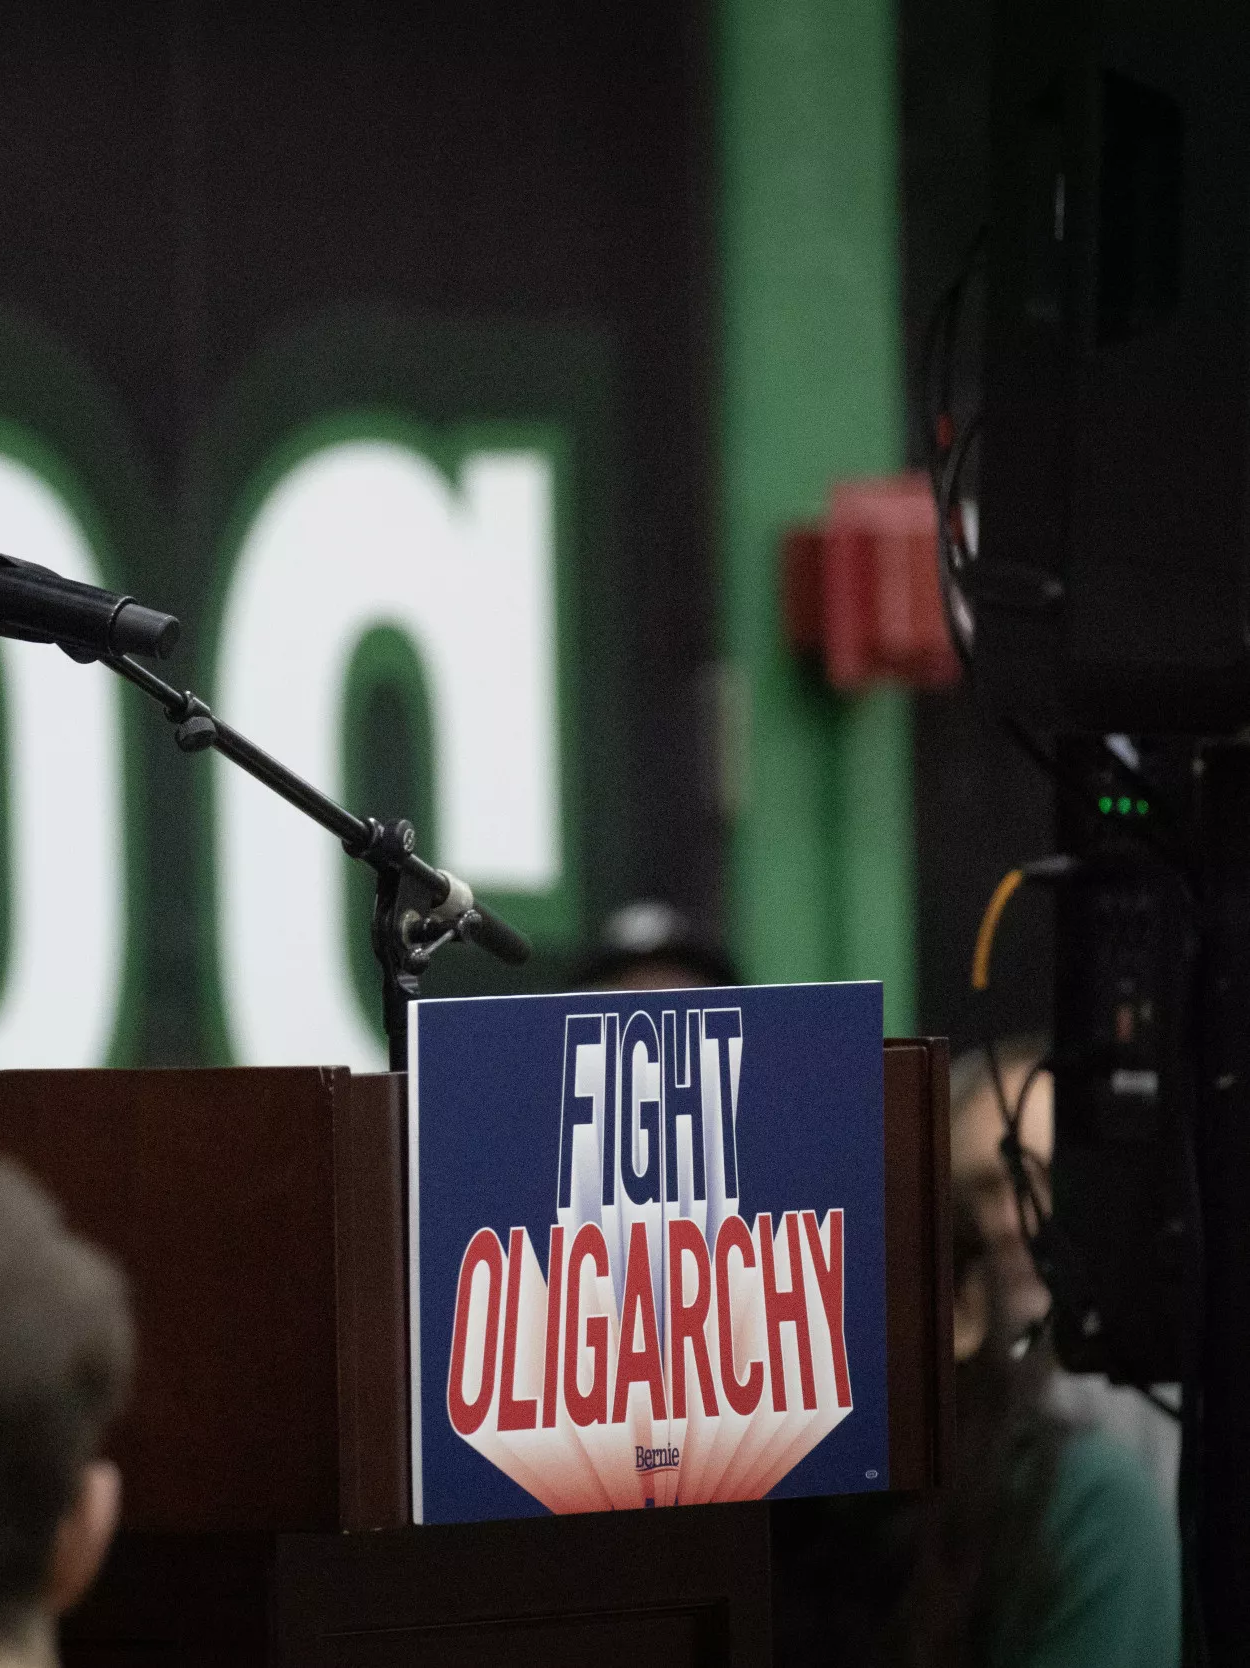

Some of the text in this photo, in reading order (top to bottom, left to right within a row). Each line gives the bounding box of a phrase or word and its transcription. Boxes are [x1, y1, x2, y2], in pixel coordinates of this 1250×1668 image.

[557, 1007, 744, 1210] FIGHT
[447, 1208, 853, 1436] OLIGARCHY
[635, 1442, 680, 1469] Bernie
